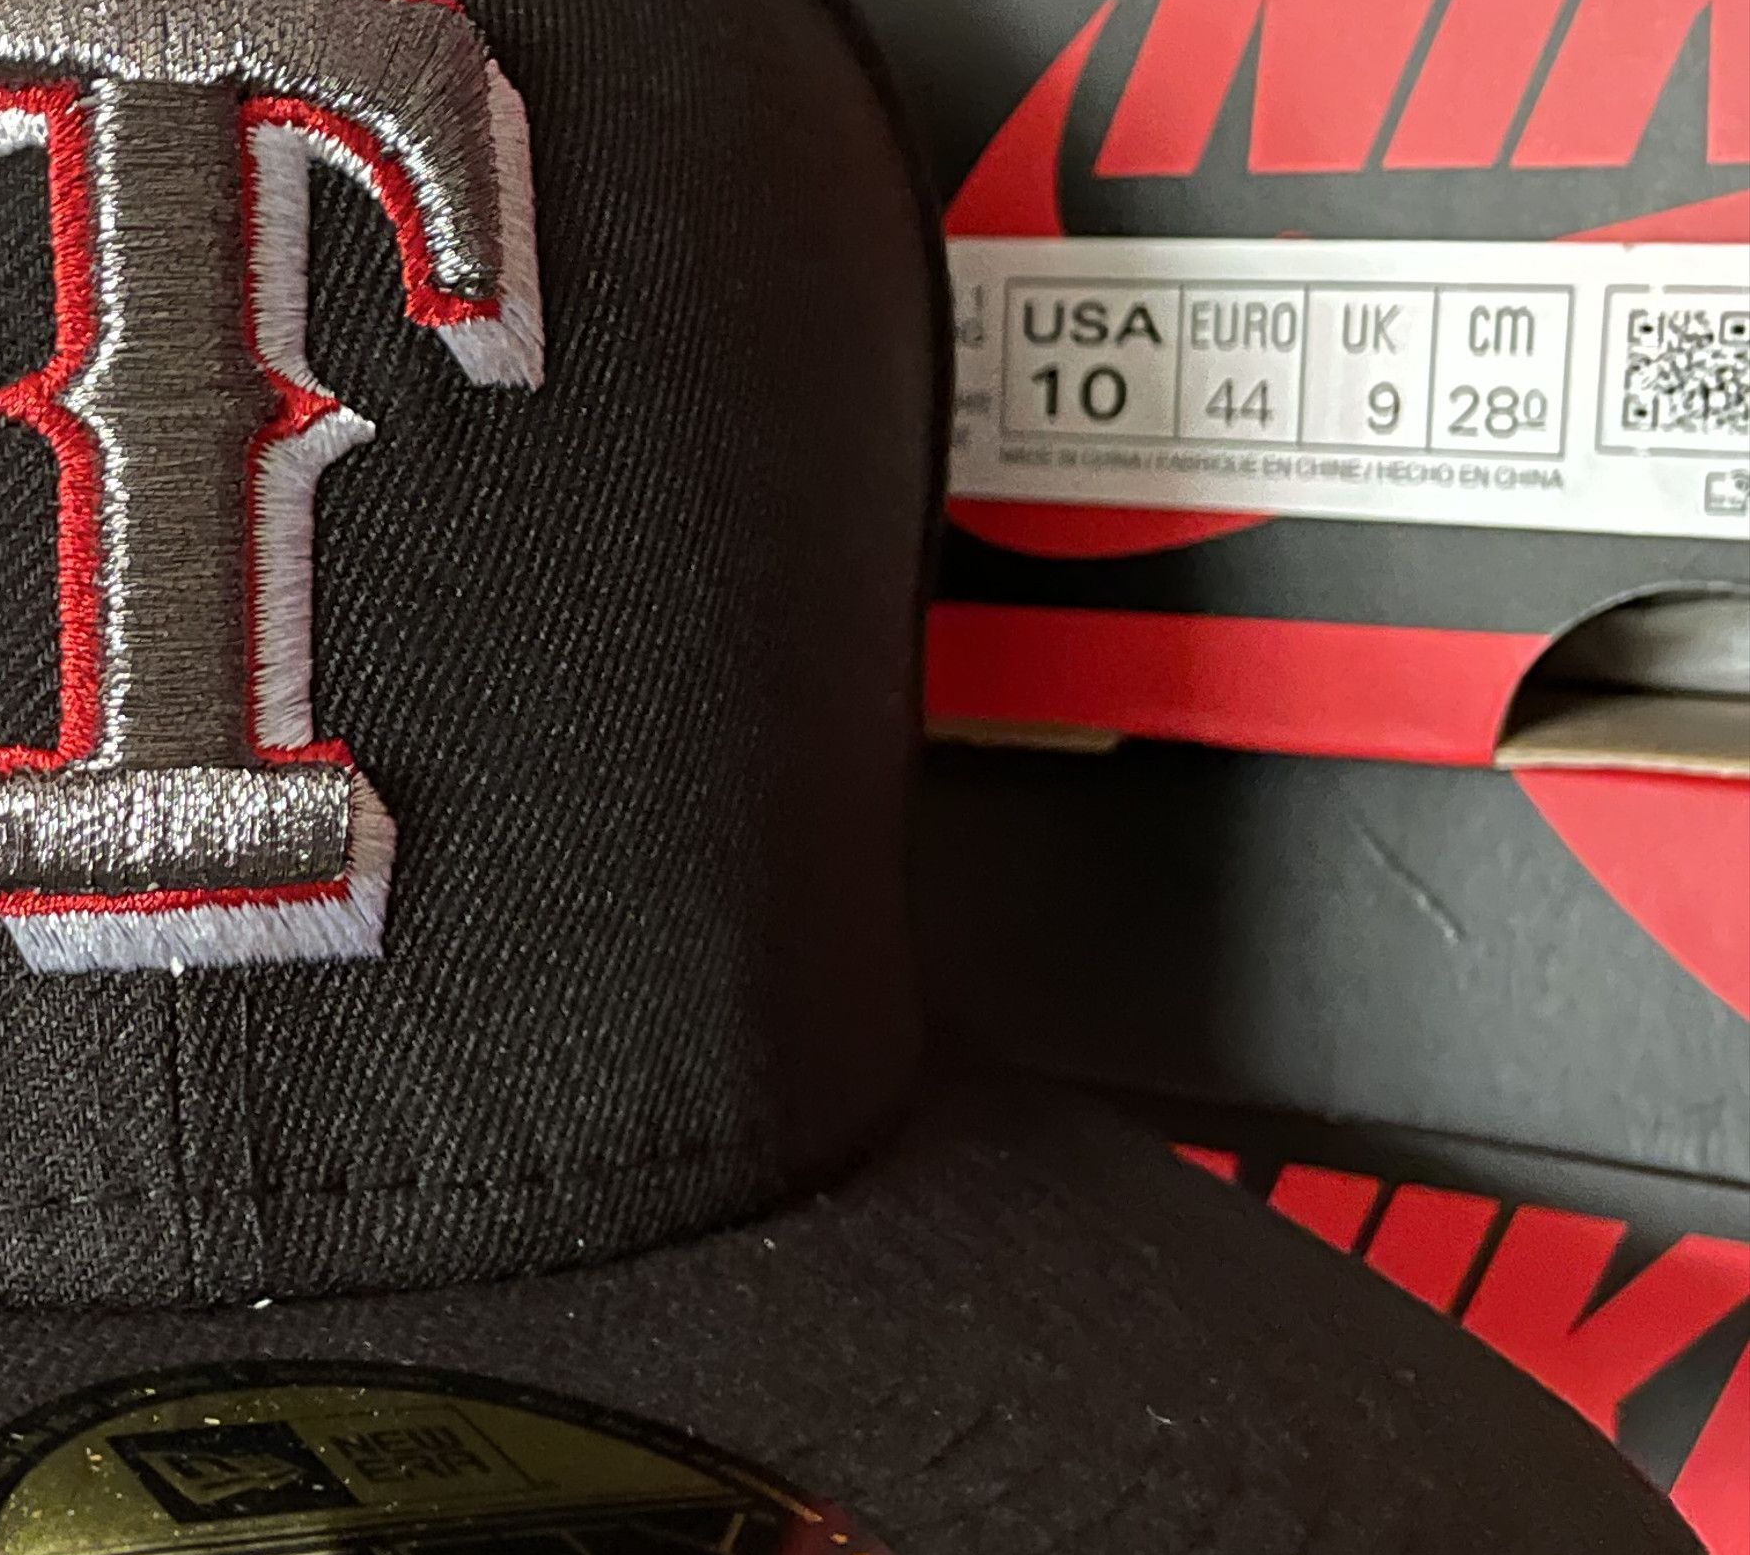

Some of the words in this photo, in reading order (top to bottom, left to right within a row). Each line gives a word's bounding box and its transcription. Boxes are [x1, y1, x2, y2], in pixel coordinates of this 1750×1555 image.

[1022, 300, 1162, 346] USA
[1190, 301, 1297, 355] EURO
[1342, 303, 1399, 354] UK
[1468, 306, 1537, 356] cm
[1030, 366, 1128, 424] 10
[1204, 378, 1273, 430] 44
[1367, 381, 1401, 436] 9
[330, 1425, 462, 1452] NEW
[355, 1452, 492, 1484] ERA
